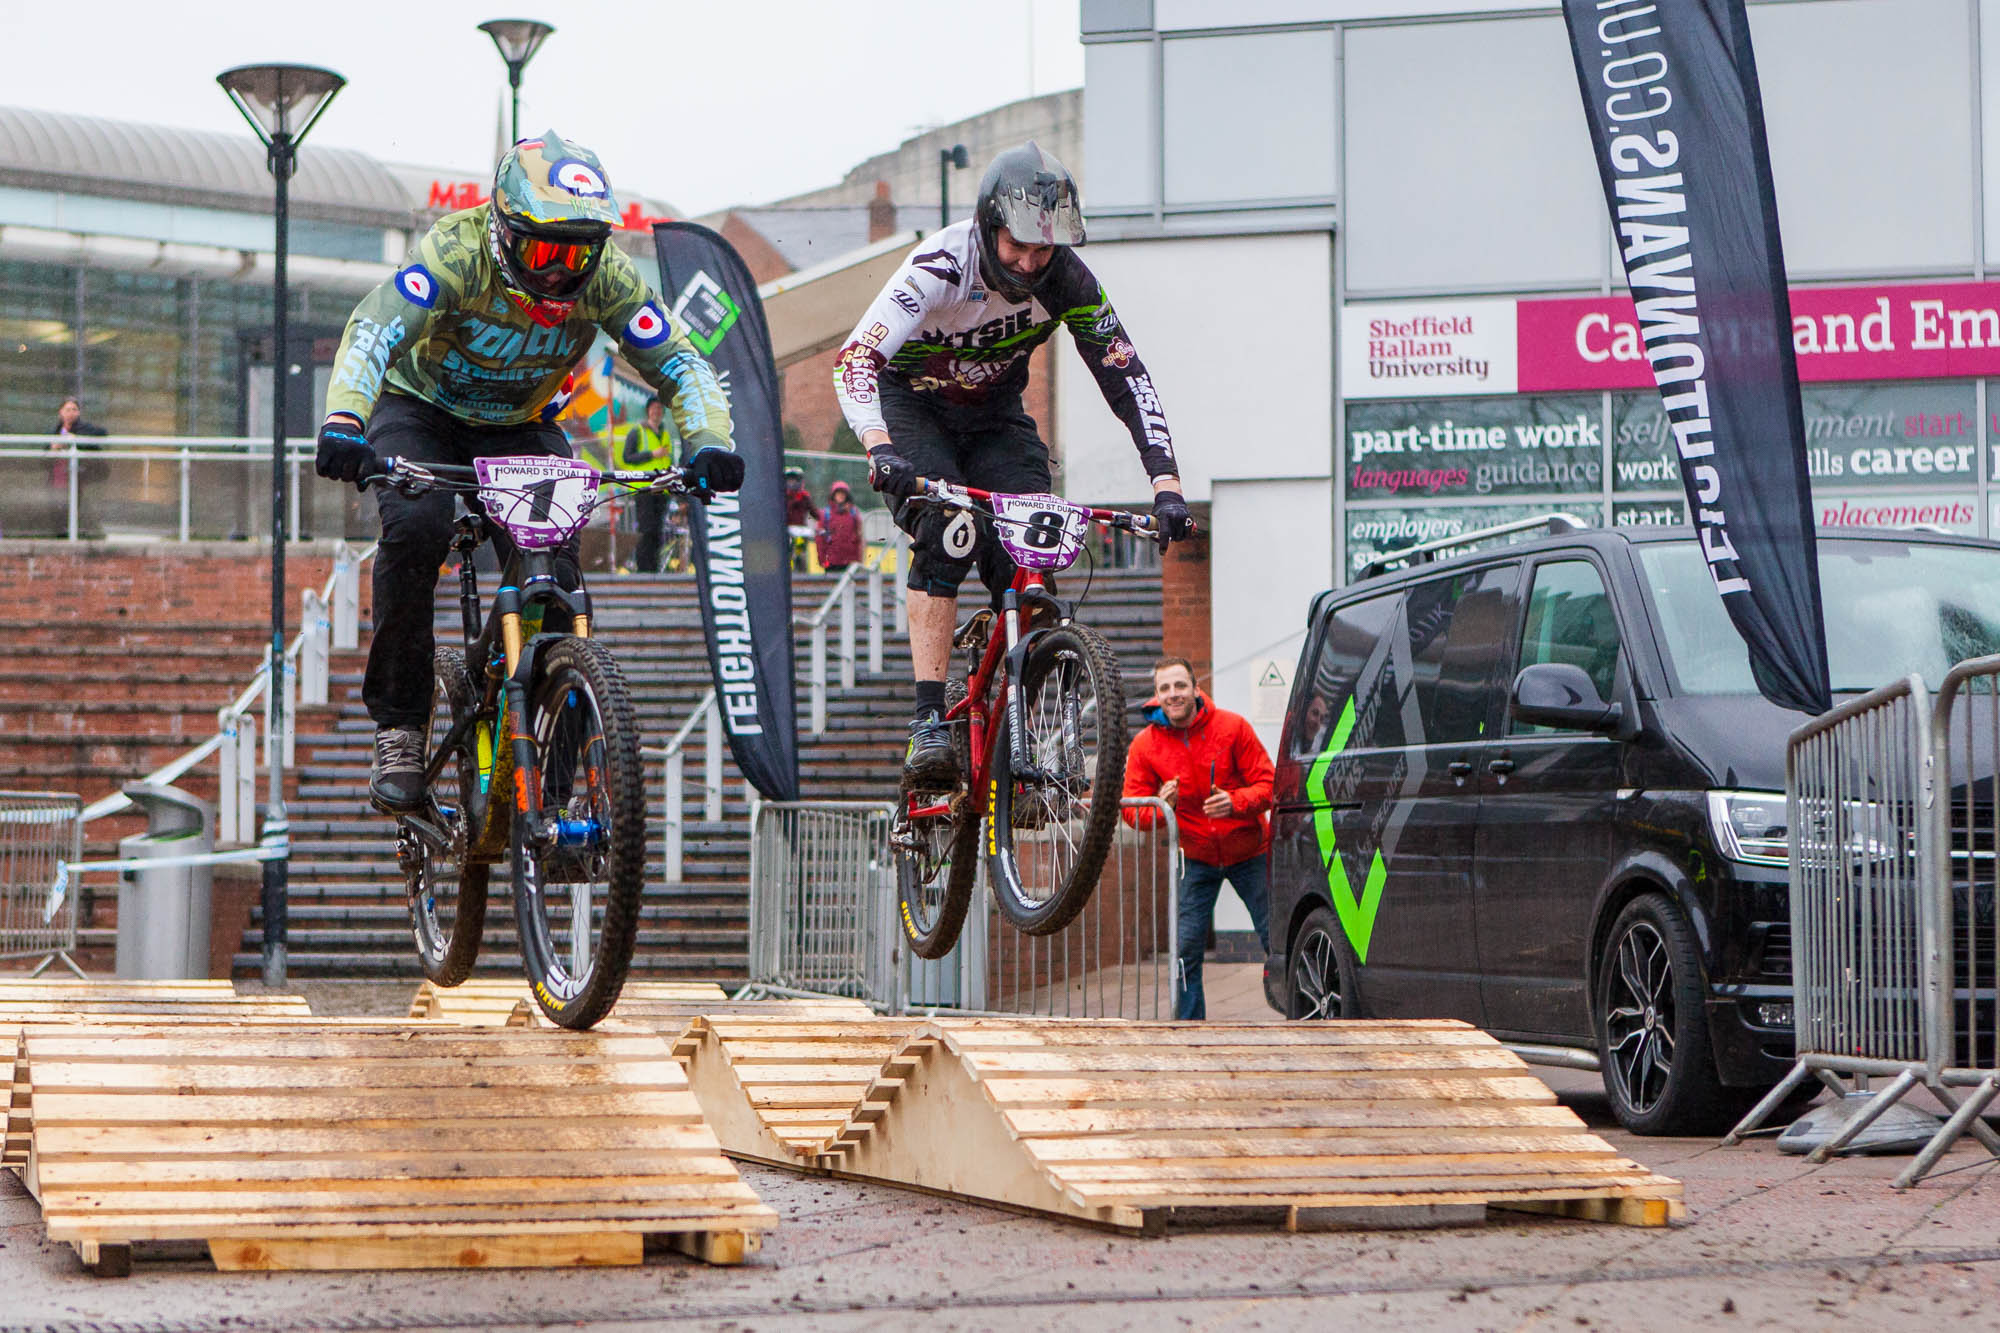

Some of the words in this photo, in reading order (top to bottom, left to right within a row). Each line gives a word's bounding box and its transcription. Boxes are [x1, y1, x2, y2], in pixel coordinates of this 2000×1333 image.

[1369, 316, 1473, 338] Sheffield
[1793, 296, 1895, 355] and
[1368, 339, 1453, 359] Hallam
[1368, 357, 1489, 381] University
[1904, 411, 1974, 437] start-
[1351, 420, 1507, 462] part-time
[1514, 414, 1600, 449] work
[498, 466, 540, 475] HOWARD
[542, 468, 555, 476] ST
[1617, 454, 1677, 482] work
[1808, 447, 1844, 477] ills
[1850, 444, 1975, 475] career
[1353, 464, 1470, 495] languages
[1475, 455, 1600, 493] guidance
[521, 478, 557, 523] 1
[1010, 500, 1044, 509] HOWARD
[1046, 502, 1056, 511] ST
[1822, 501, 1974, 527] placements
[1023, 511, 1065, 549] 8
[1352, 514, 1463, 544] employers
[1617, 507, 1681, 527] start-
